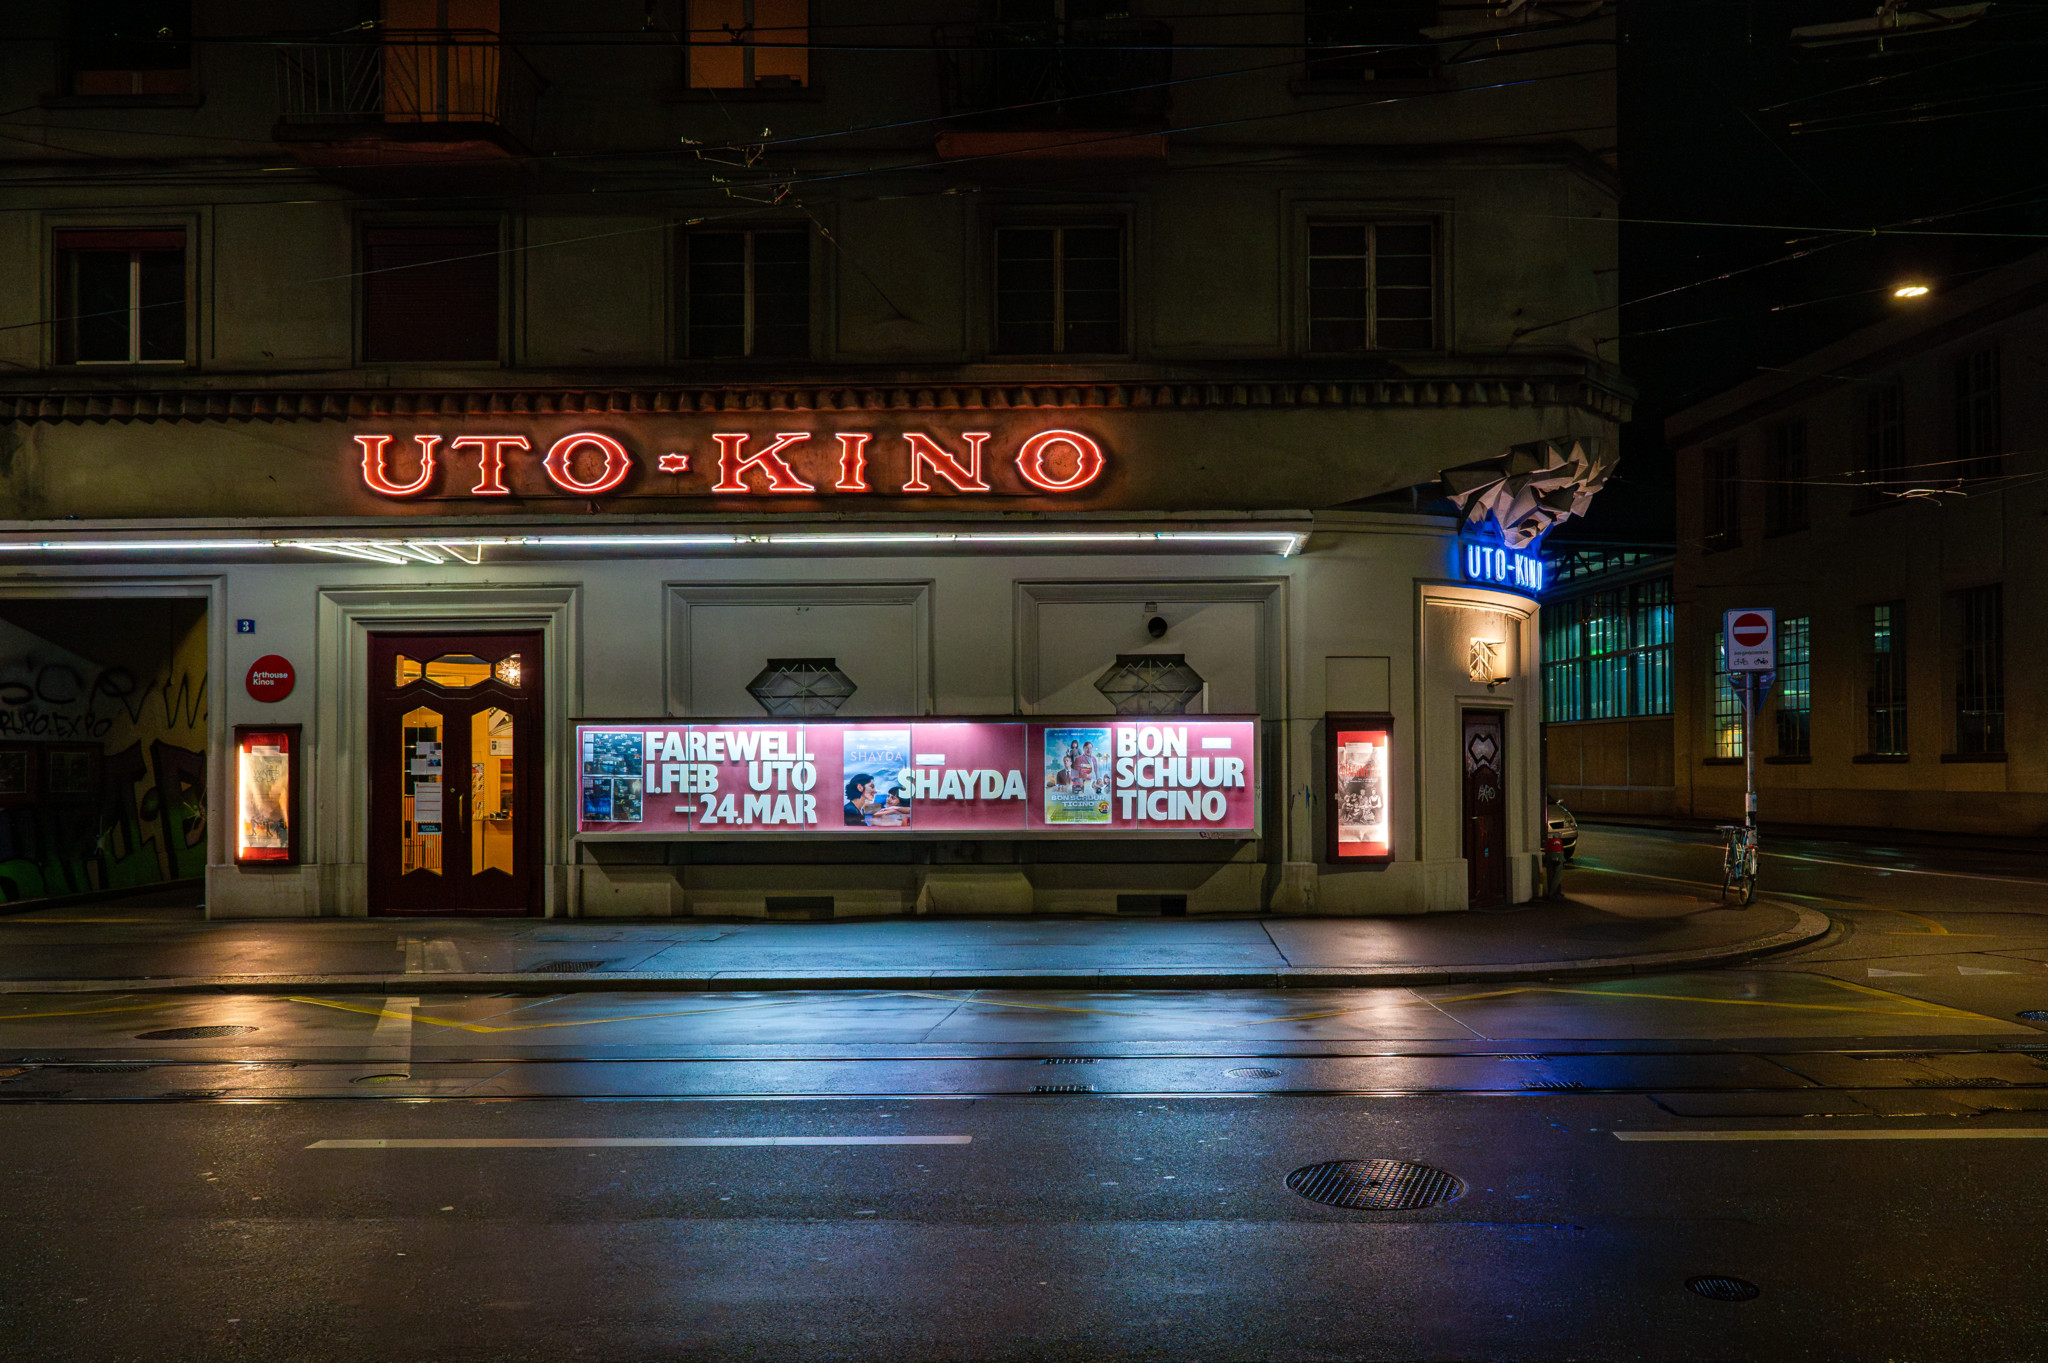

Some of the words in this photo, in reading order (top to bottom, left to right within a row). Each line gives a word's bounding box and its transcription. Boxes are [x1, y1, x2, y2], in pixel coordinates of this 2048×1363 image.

[1467, 544, 1543, 591] UTO-KINO
[242, 620, 250, 632] 3
[253, 671, 288, 679] Arthouse
[646, 731, 815, 761] FAREWELL
[850, 751, 904, 762] SHAYDA
[1117, 726, 1188, 758] BON
[749, 761, 817, 792] UTO
[897, 768, 1027, 800] SHAYDA
[1116, 756, 1245, 788] SCHUUR
[1116, 789, 1227, 821] TICINO
